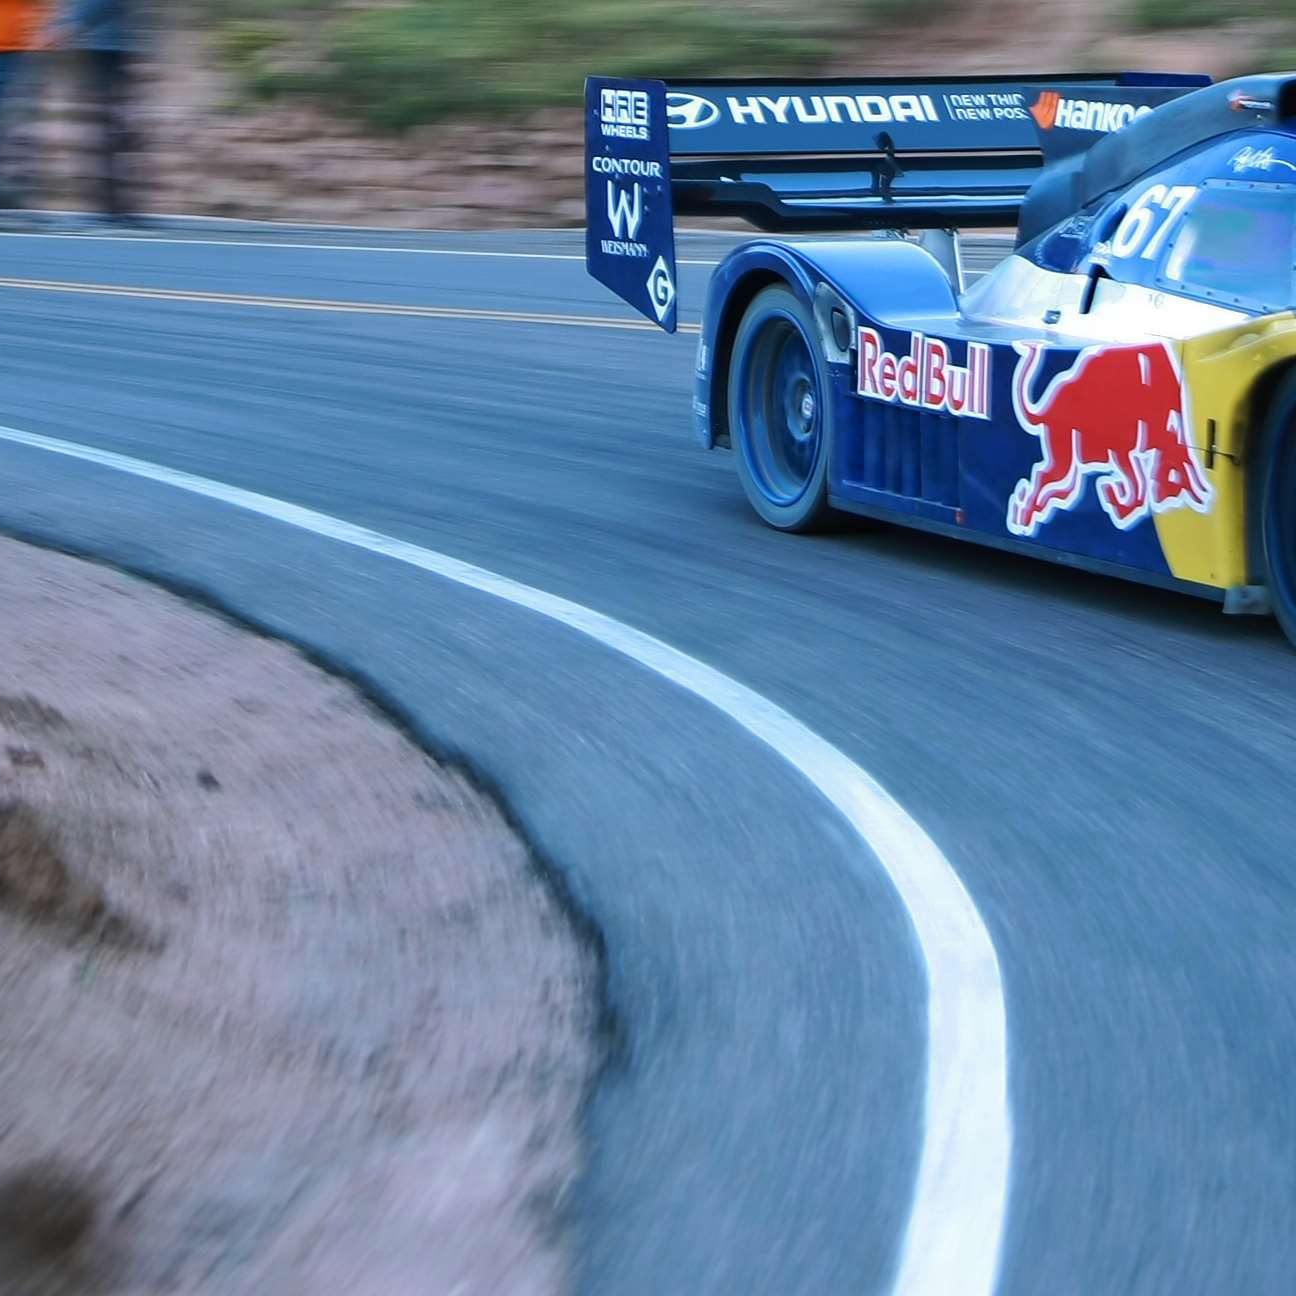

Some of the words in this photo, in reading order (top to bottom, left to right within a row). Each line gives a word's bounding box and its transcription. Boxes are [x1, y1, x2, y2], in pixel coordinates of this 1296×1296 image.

[725, 94, 941, 125] HYUNDAI
[949, 94, 988, 107] NEW
[954, 108, 993, 121] NEW
[1054, 97, 1155, 134] Hanko
[600, 123, 651, 140] WHEELS
[591, 156, 663, 178] CONTOUR
[607, 179, 643, 240] W
[1111, 183, 1200, 261] 67
